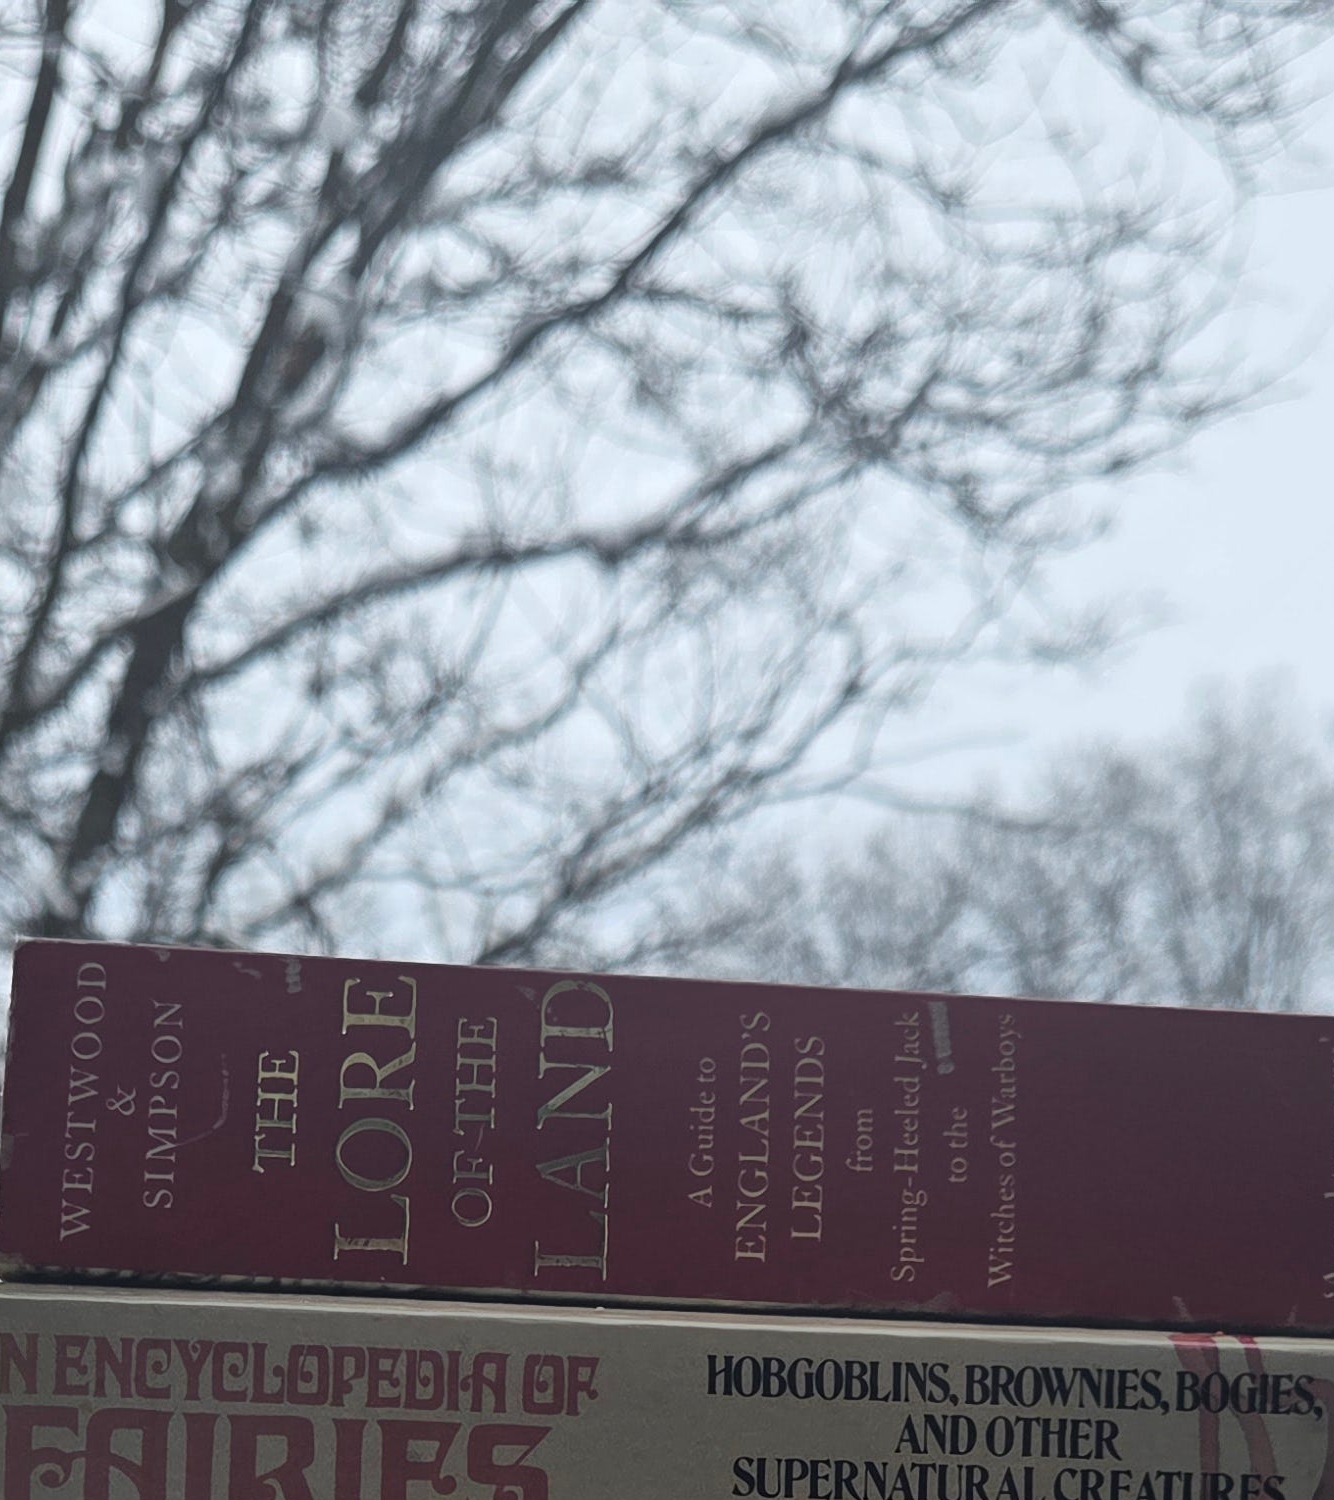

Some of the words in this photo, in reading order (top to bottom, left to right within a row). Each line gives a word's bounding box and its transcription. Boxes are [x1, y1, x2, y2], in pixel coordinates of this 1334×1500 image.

[455, 1016, 498, 1134] THE
[697, 1056, 716, 1088] to
[894, 1010, 928, 1070] Jack
[990, 1013, 1022, 1130] Warboys
[60, 960, 108, 1242] WESTWOOD
[106, 1084, 137, 1116] &
[143, 1000, 183, 1209] SIMPSON
[252, 1049, 299, 1174] THE
[333, 974, 417, 1266] LORE
[534, 979, 614, 1281] LAND
[688, 1092, 716, 1177] Guide
[735, 1010, 771, 1263] ENGLAND'S
[791, 1035, 825, 1242] LEGENDS
[845, 1107, 874, 1173] from
[943, 1105, 968, 1153] the
[452, 1149, 494, 1228] OF
[890, 1074, 928, 1283] Spring-Heeled
[948, 1157, 967, 1184] to
[989, 1134, 1017, 1168] of
[688, 1185, 713, 1208] A
[988, 1173, 1017, 1288] Witches
[54, 1333, 510, 1414] ENCYCLOPEDIA
[522, 1353, 600, 1417] OF
[705, 1354, 959, 1407] HOBGOBLINS,
[966, 1364, 1170, 1417] BROWNIES,
[1174, 1375, 1323, 1421] BOGIES,
[895, 1414, 977, 1456] AND
[985, 1417, 1122, 1461] OTHER
